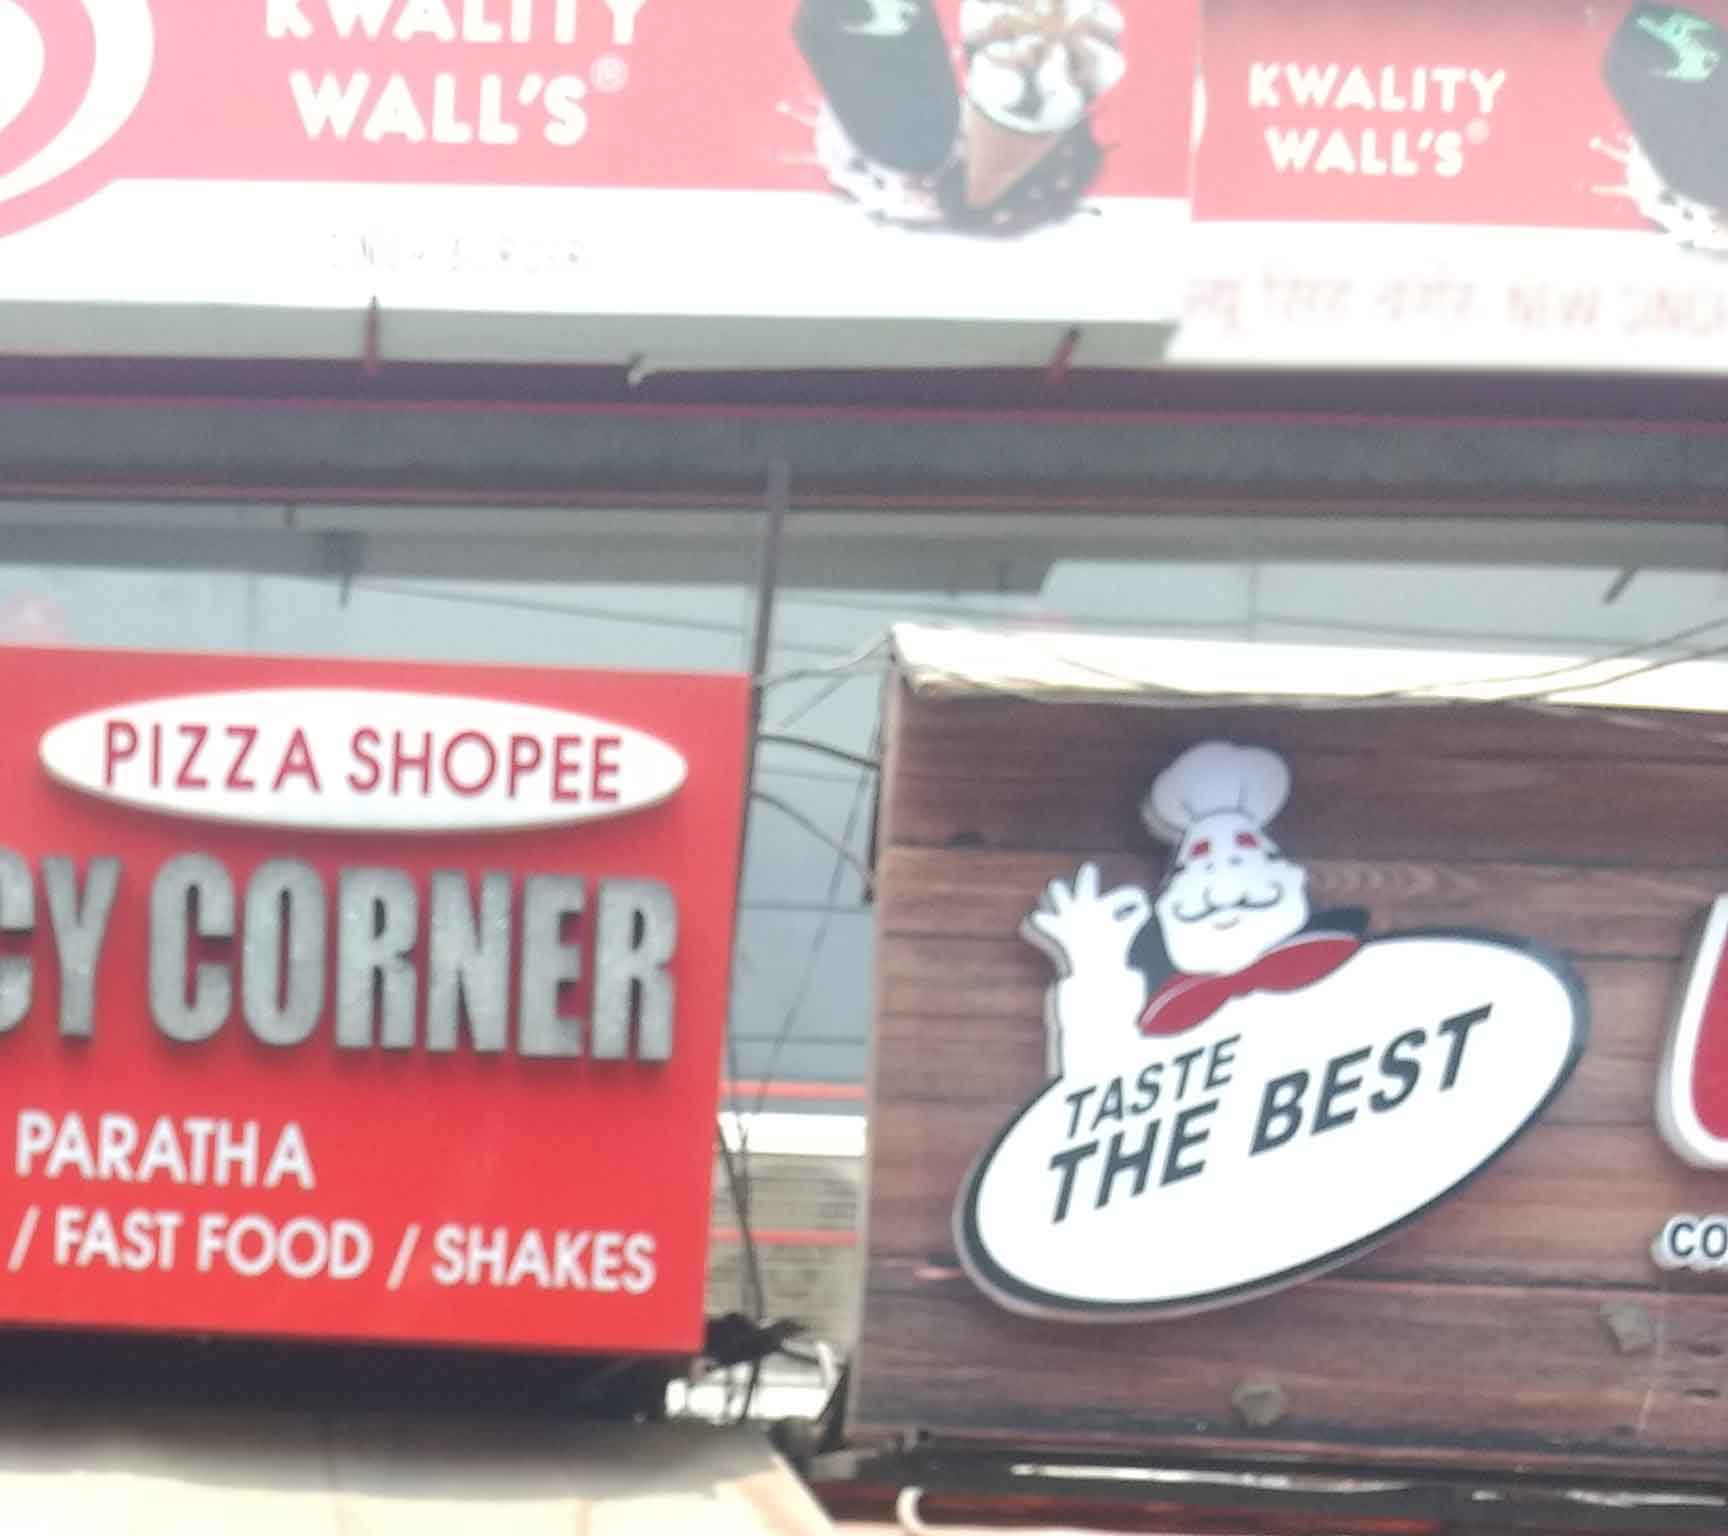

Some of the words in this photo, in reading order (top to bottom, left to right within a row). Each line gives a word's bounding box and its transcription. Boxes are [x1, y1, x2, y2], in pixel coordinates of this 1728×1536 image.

[1248, 61, 1506, 114] KWALITY
[102, 720, 321, 793] PIZZA
[347, 729, 623, 801] SHOPEE
[148, 852, 679, 1062] CORNER
[1048, 1098, 1218, 1225] THE
[1248, 1003, 1493, 1156] BEST
[1064, 1034, 1242, 1138] TASTE
[16, 1109, 316, 1189] PARATHA
[53, 1206, 183, 1272] FAST
[197, 1214, 372, 1280] FOOD
[431, 1225, 658, 1295] SHAKES
